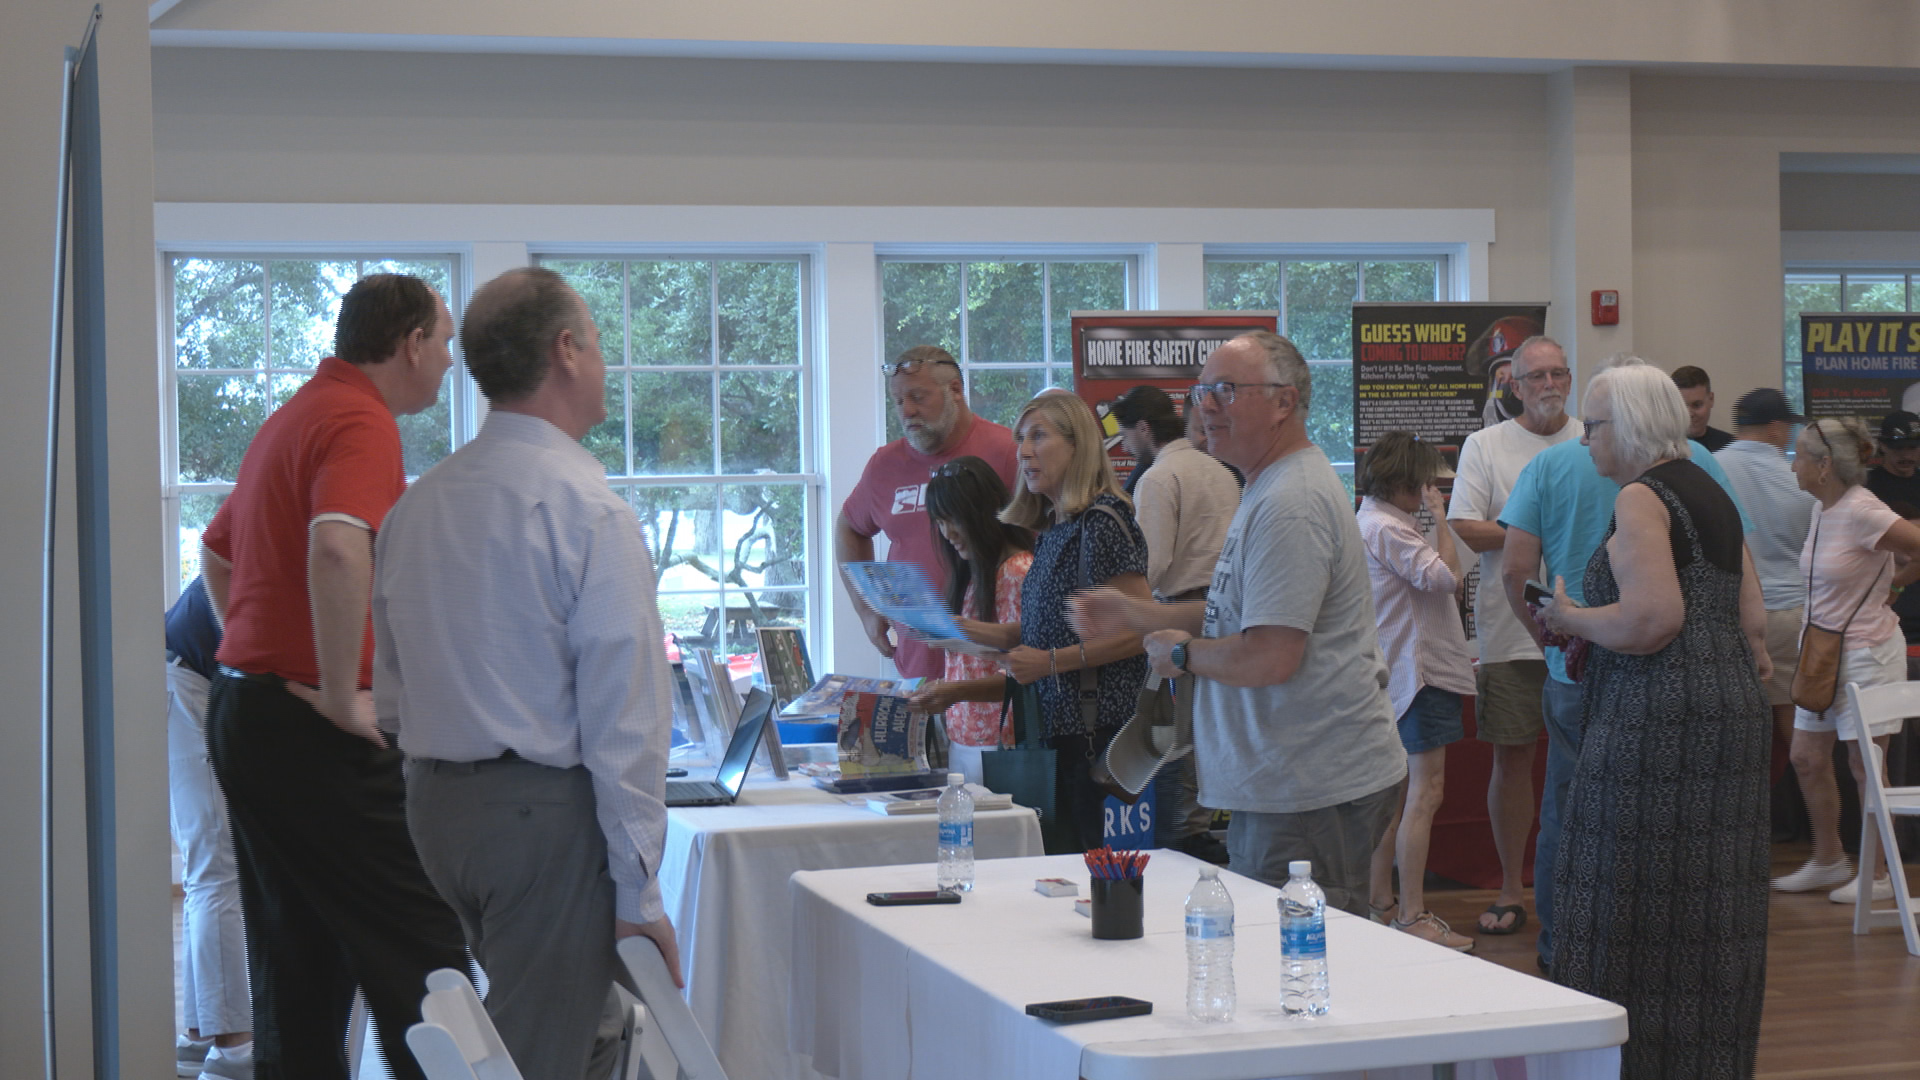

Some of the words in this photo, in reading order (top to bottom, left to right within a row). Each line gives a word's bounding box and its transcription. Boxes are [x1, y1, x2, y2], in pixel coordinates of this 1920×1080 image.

[1361, 323, 1411, 343] GUESS
[1414, 323, 1466, 343] WHO'S
[1807, 322, 1873, 352] PLAY
[1878, 322, 1903, 352] IT
[1087, 340, 1123, 366] HOME
[1125, 340, 1151, 366] FIRE
[1153, 340, 1196, 366] SAFETY
[1199, 340, 1228, 366] CH
[1361, 344, 1403, 361] COMING
[1406, 344, 1419, 361] TO
[1420, 344, 1466, 361] DINNER?
[1427, 365, 1464, 374] Department.
[1815, 357, 1847, 370] PLAN
[1851, 357, 1888, 370] HOME
[1892, 357, 1917, 370] FIRE
[1103, 801, 1151, 838] RKS
